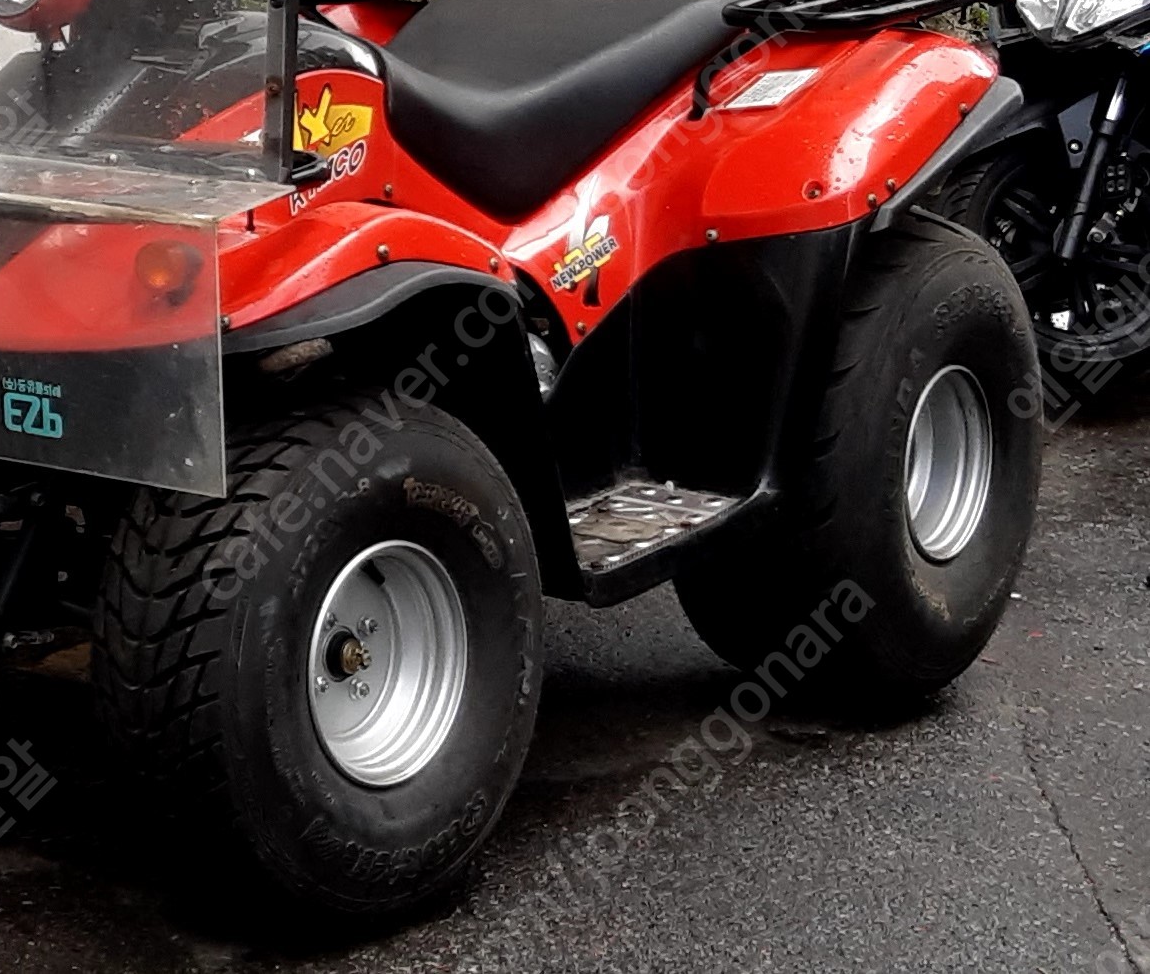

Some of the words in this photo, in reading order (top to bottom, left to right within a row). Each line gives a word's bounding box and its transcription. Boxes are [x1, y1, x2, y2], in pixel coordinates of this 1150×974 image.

[289, 139, 367, 216] KCO
[552, 264, 579, 290] NEW
[578, 237, 617, 272] POWER
